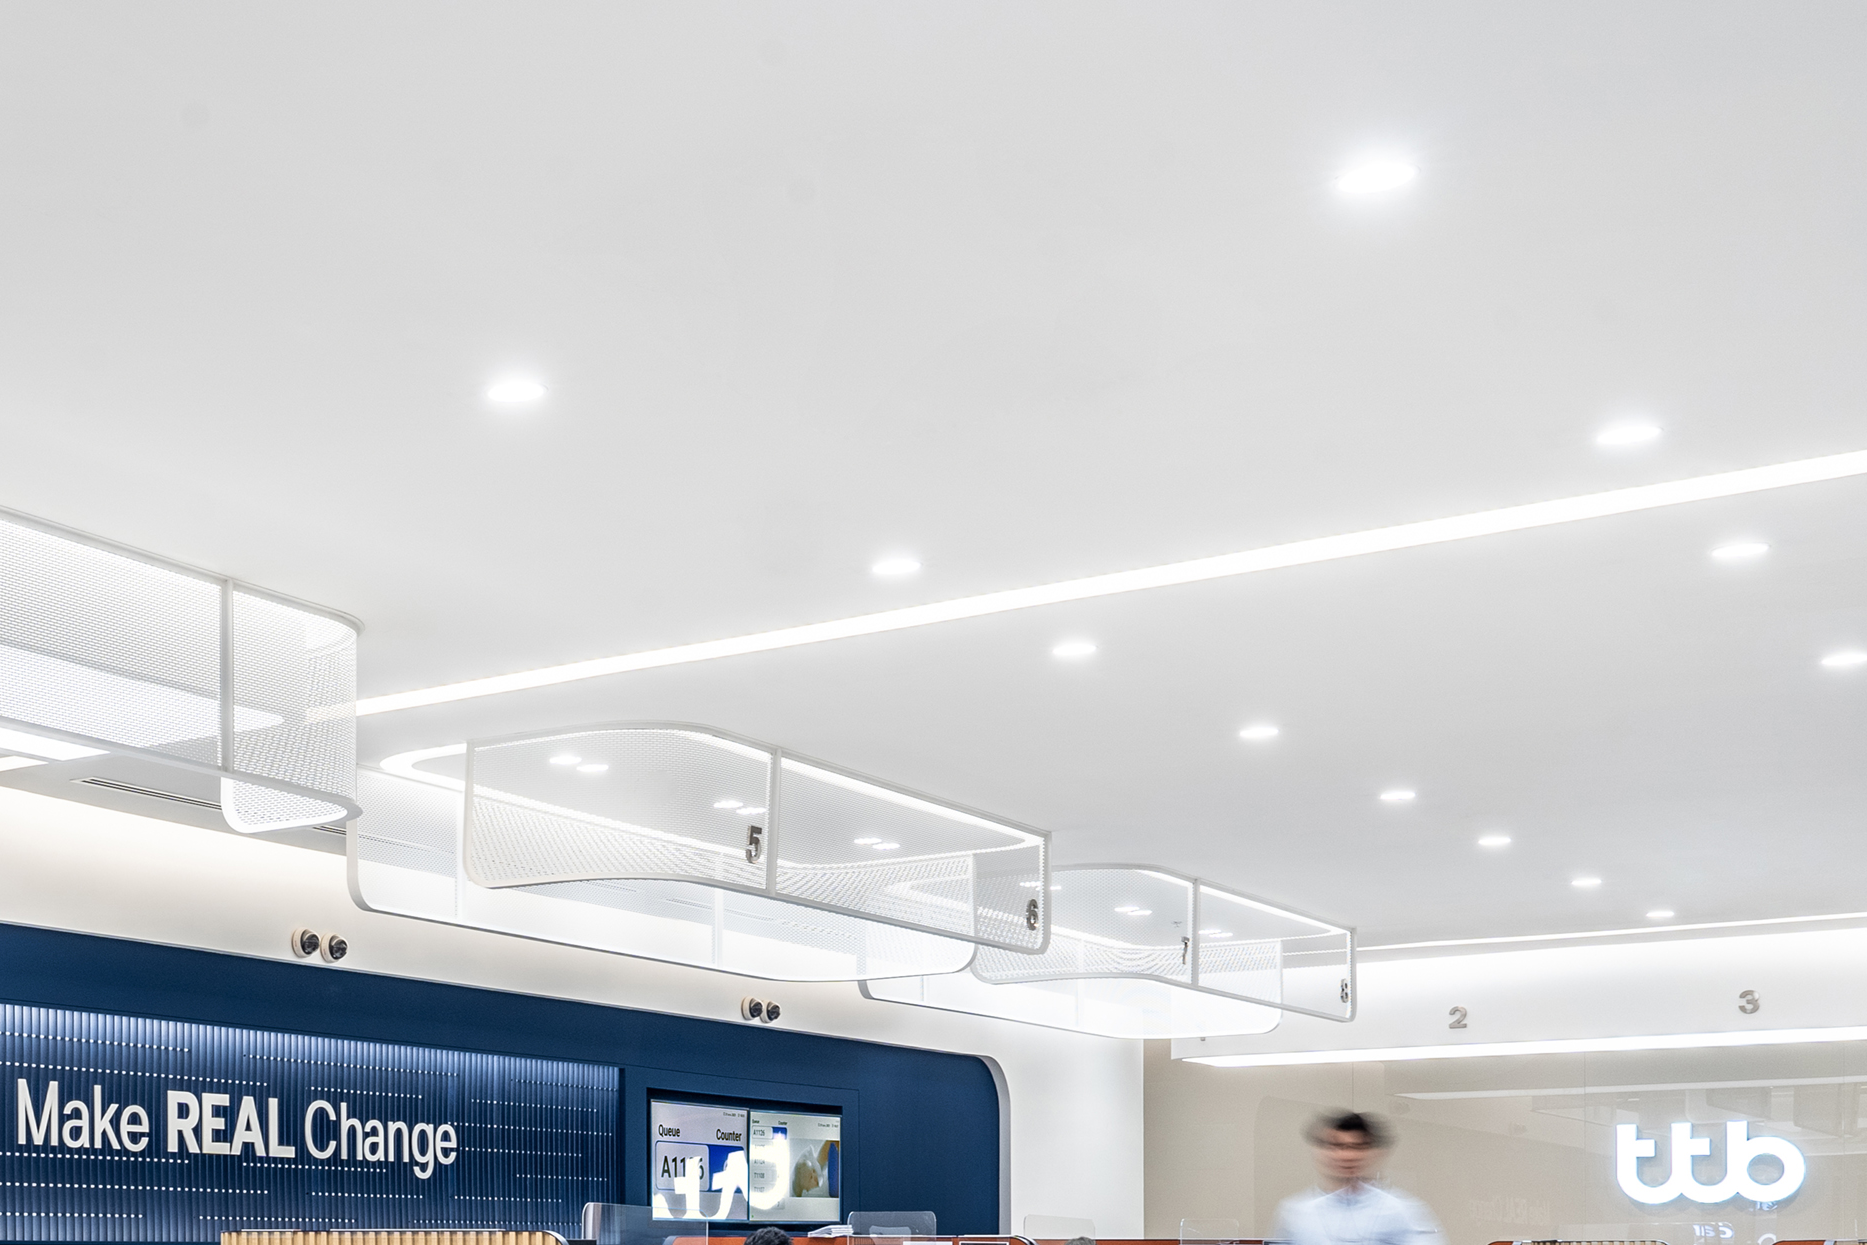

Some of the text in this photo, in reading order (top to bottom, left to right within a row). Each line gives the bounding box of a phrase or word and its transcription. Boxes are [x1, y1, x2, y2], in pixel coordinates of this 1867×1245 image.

[745, 825, 763, 864] 5
[1025, 899, 1039, 931] 6
[1340, 978, 1349, 1003] 8
[1738, 989, 1761, 1014] 3
[1448, 1005, 1469, 1029] 2
[17, 1078, 458, 1179] Make REAL Change
[658, 1124, 742, 1142] Queue Counter
[661, 1155, 705, 1180] A116
[1615, 1120, 1807, 1205] ttb
